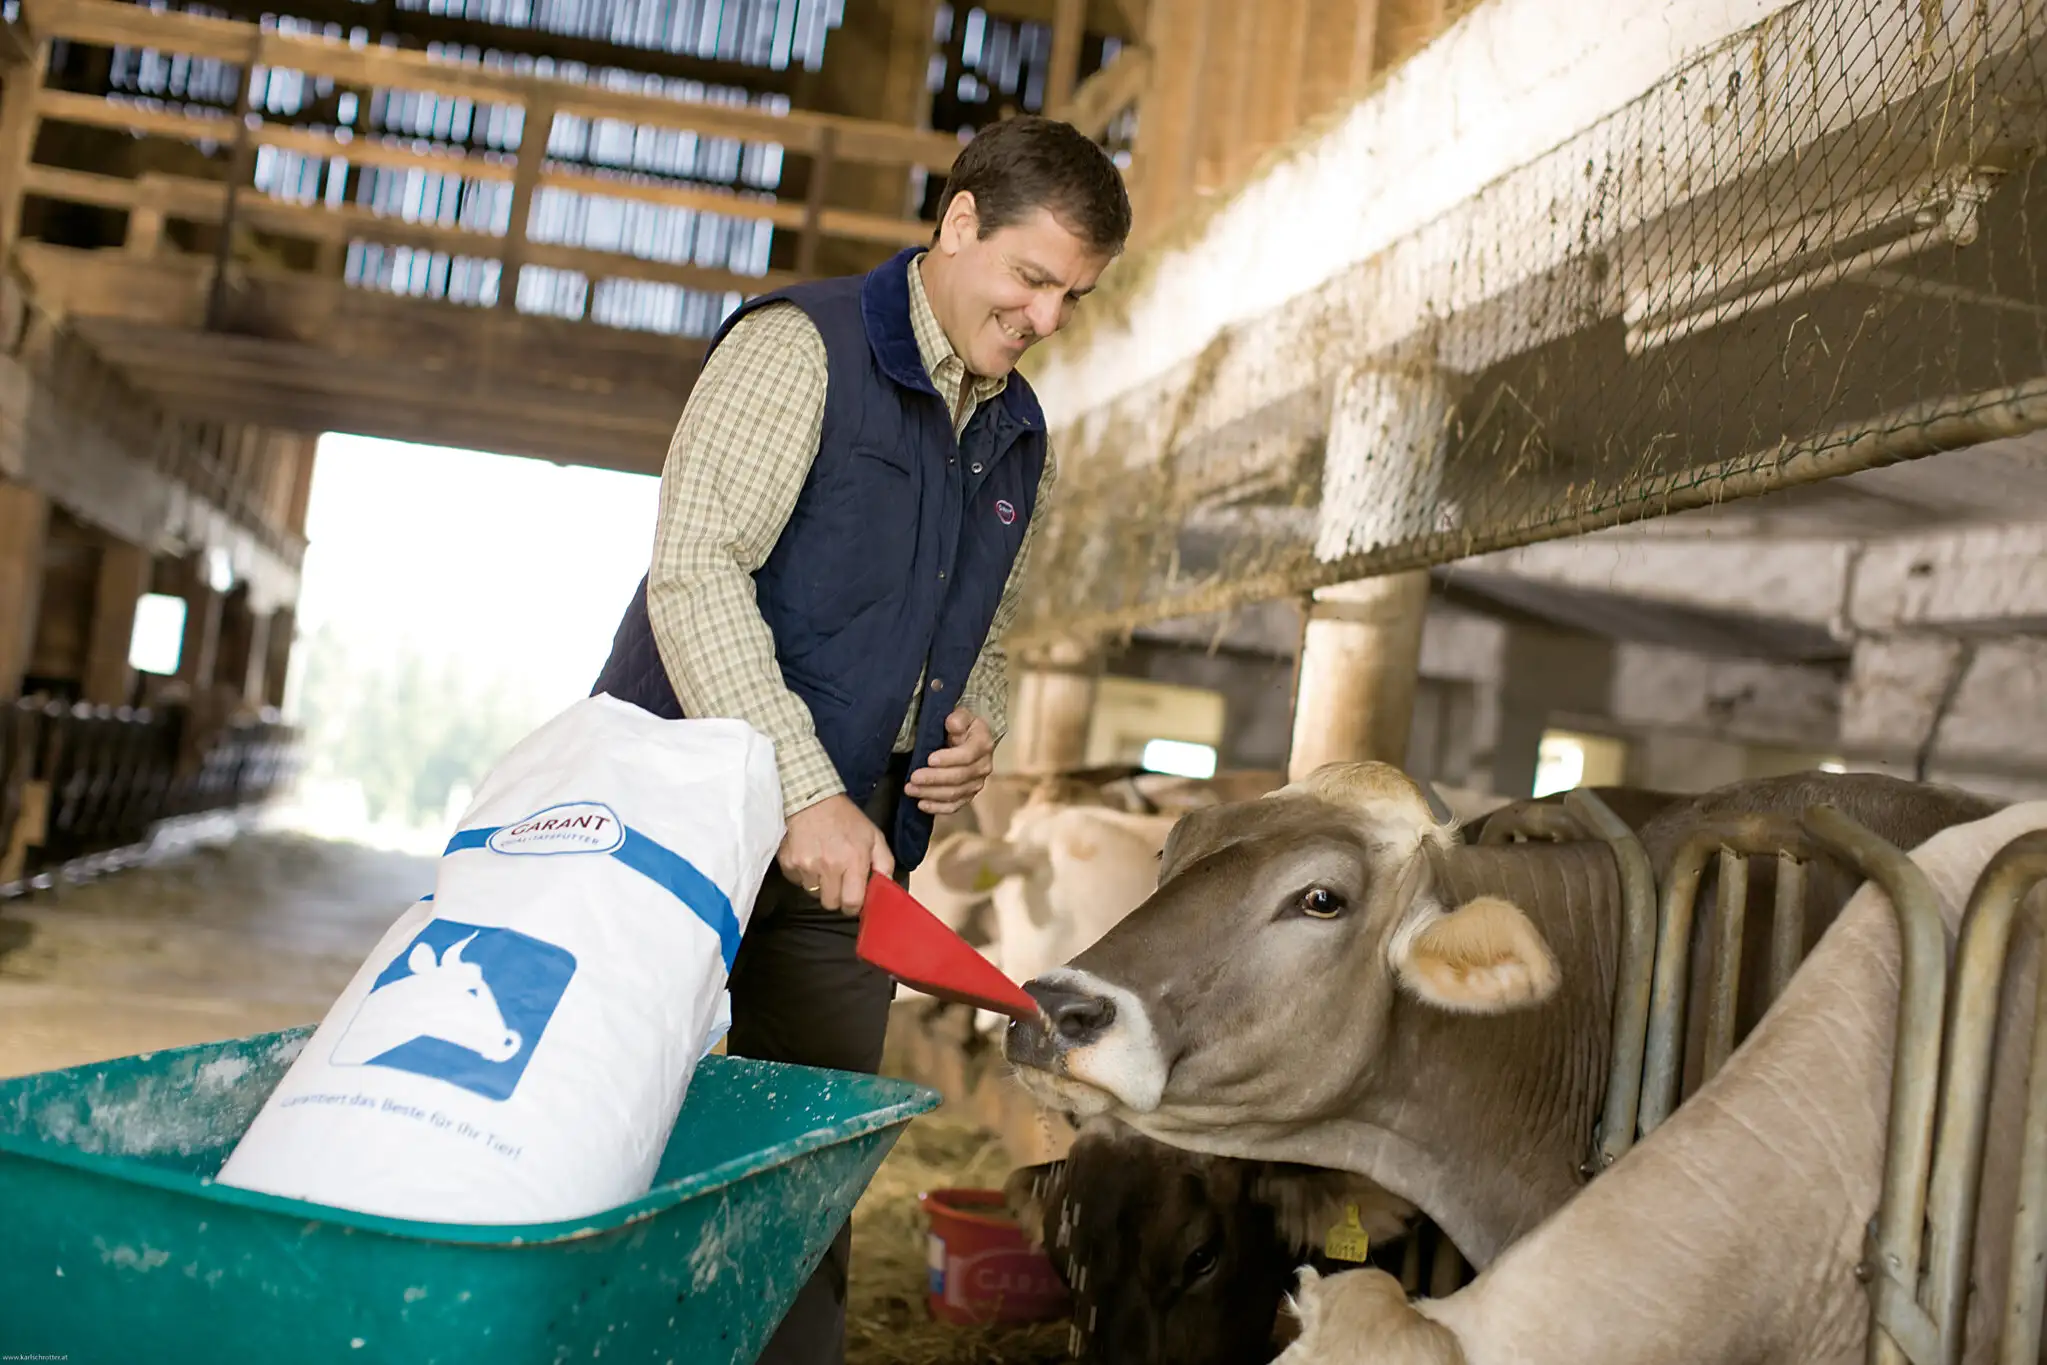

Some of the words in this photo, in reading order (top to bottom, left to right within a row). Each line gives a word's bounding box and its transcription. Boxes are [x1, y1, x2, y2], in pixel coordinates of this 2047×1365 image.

[511, 815, 611, 835] GARANT
[349, 1091, 376, 1109] das
[381, 1098, 425, 1121] Beste
[429, 1110, 453, 1129] für
